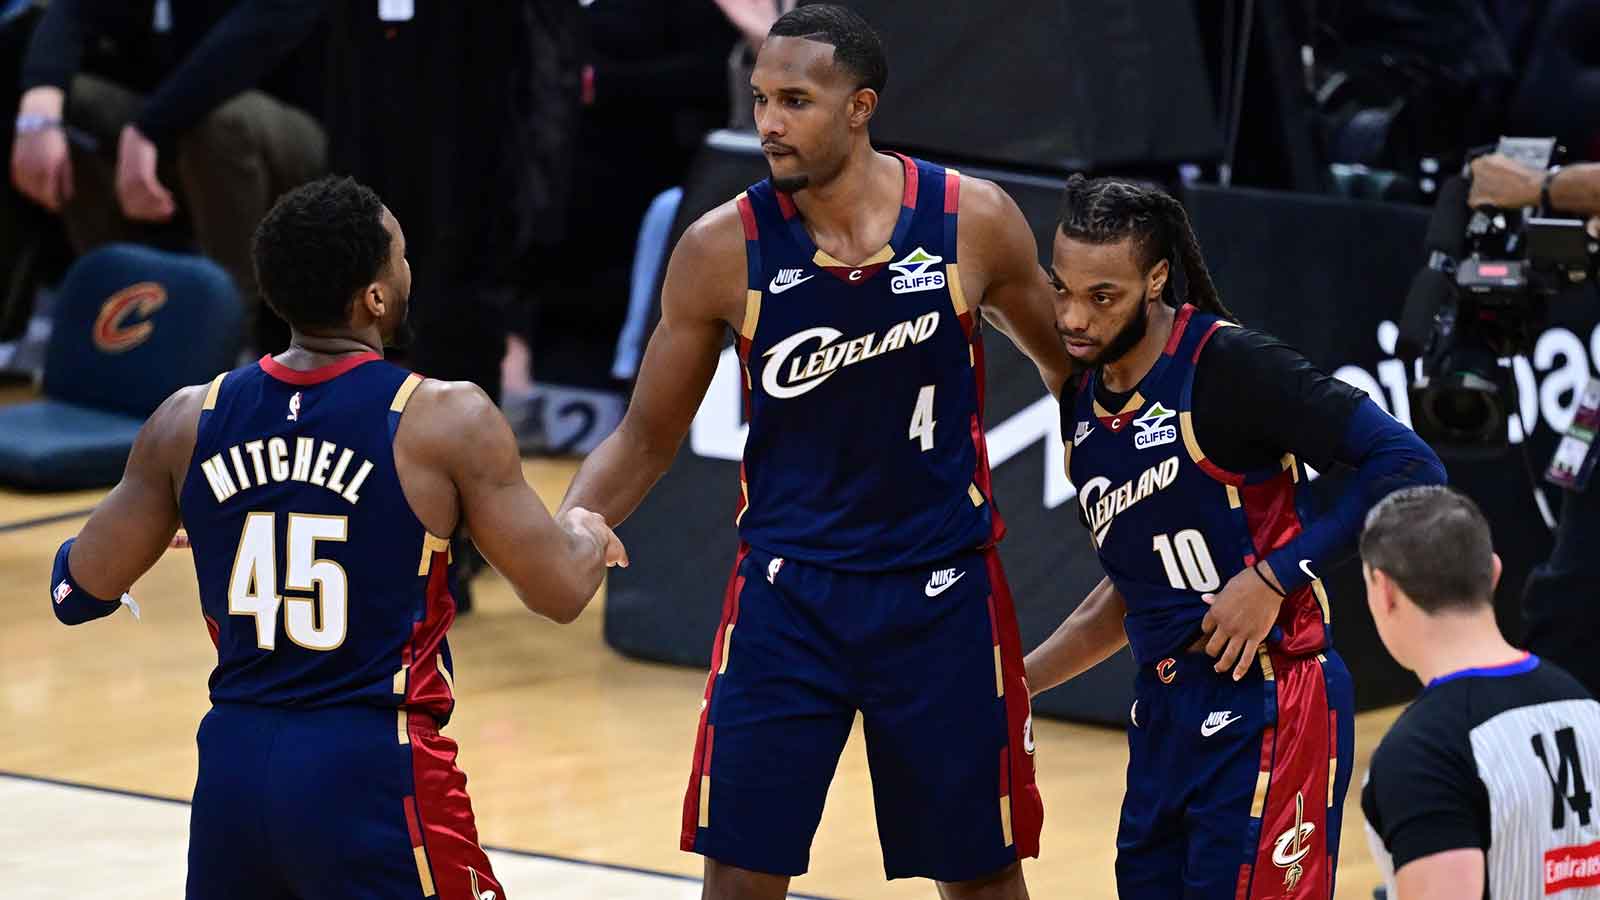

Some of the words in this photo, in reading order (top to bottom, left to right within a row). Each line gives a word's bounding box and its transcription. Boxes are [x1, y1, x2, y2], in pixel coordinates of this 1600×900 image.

[775, 269, 804, 285] NIKE
[893, 275, 944, 290] CLIFFS
[94, 281, 167, 354] C
[762, 312, 940, 399] CLEVELAND
[909, 385, 937, 452] 4
[1136, 428, 1175, 446] CLIFFS
[200, 437, 375, 505] MITCHELL
[1079, 456, 1179, 549] CLEVELAND
[228, 512, 349, 652] 45
[931, 568, 956, 586] NIKE
[1153, 529, 1221, 593] 10
[1156, 657, 1177, 684] C
[1206, 711, 1232, 727] NIKE
[1530, 727, 1592, 831] 14
